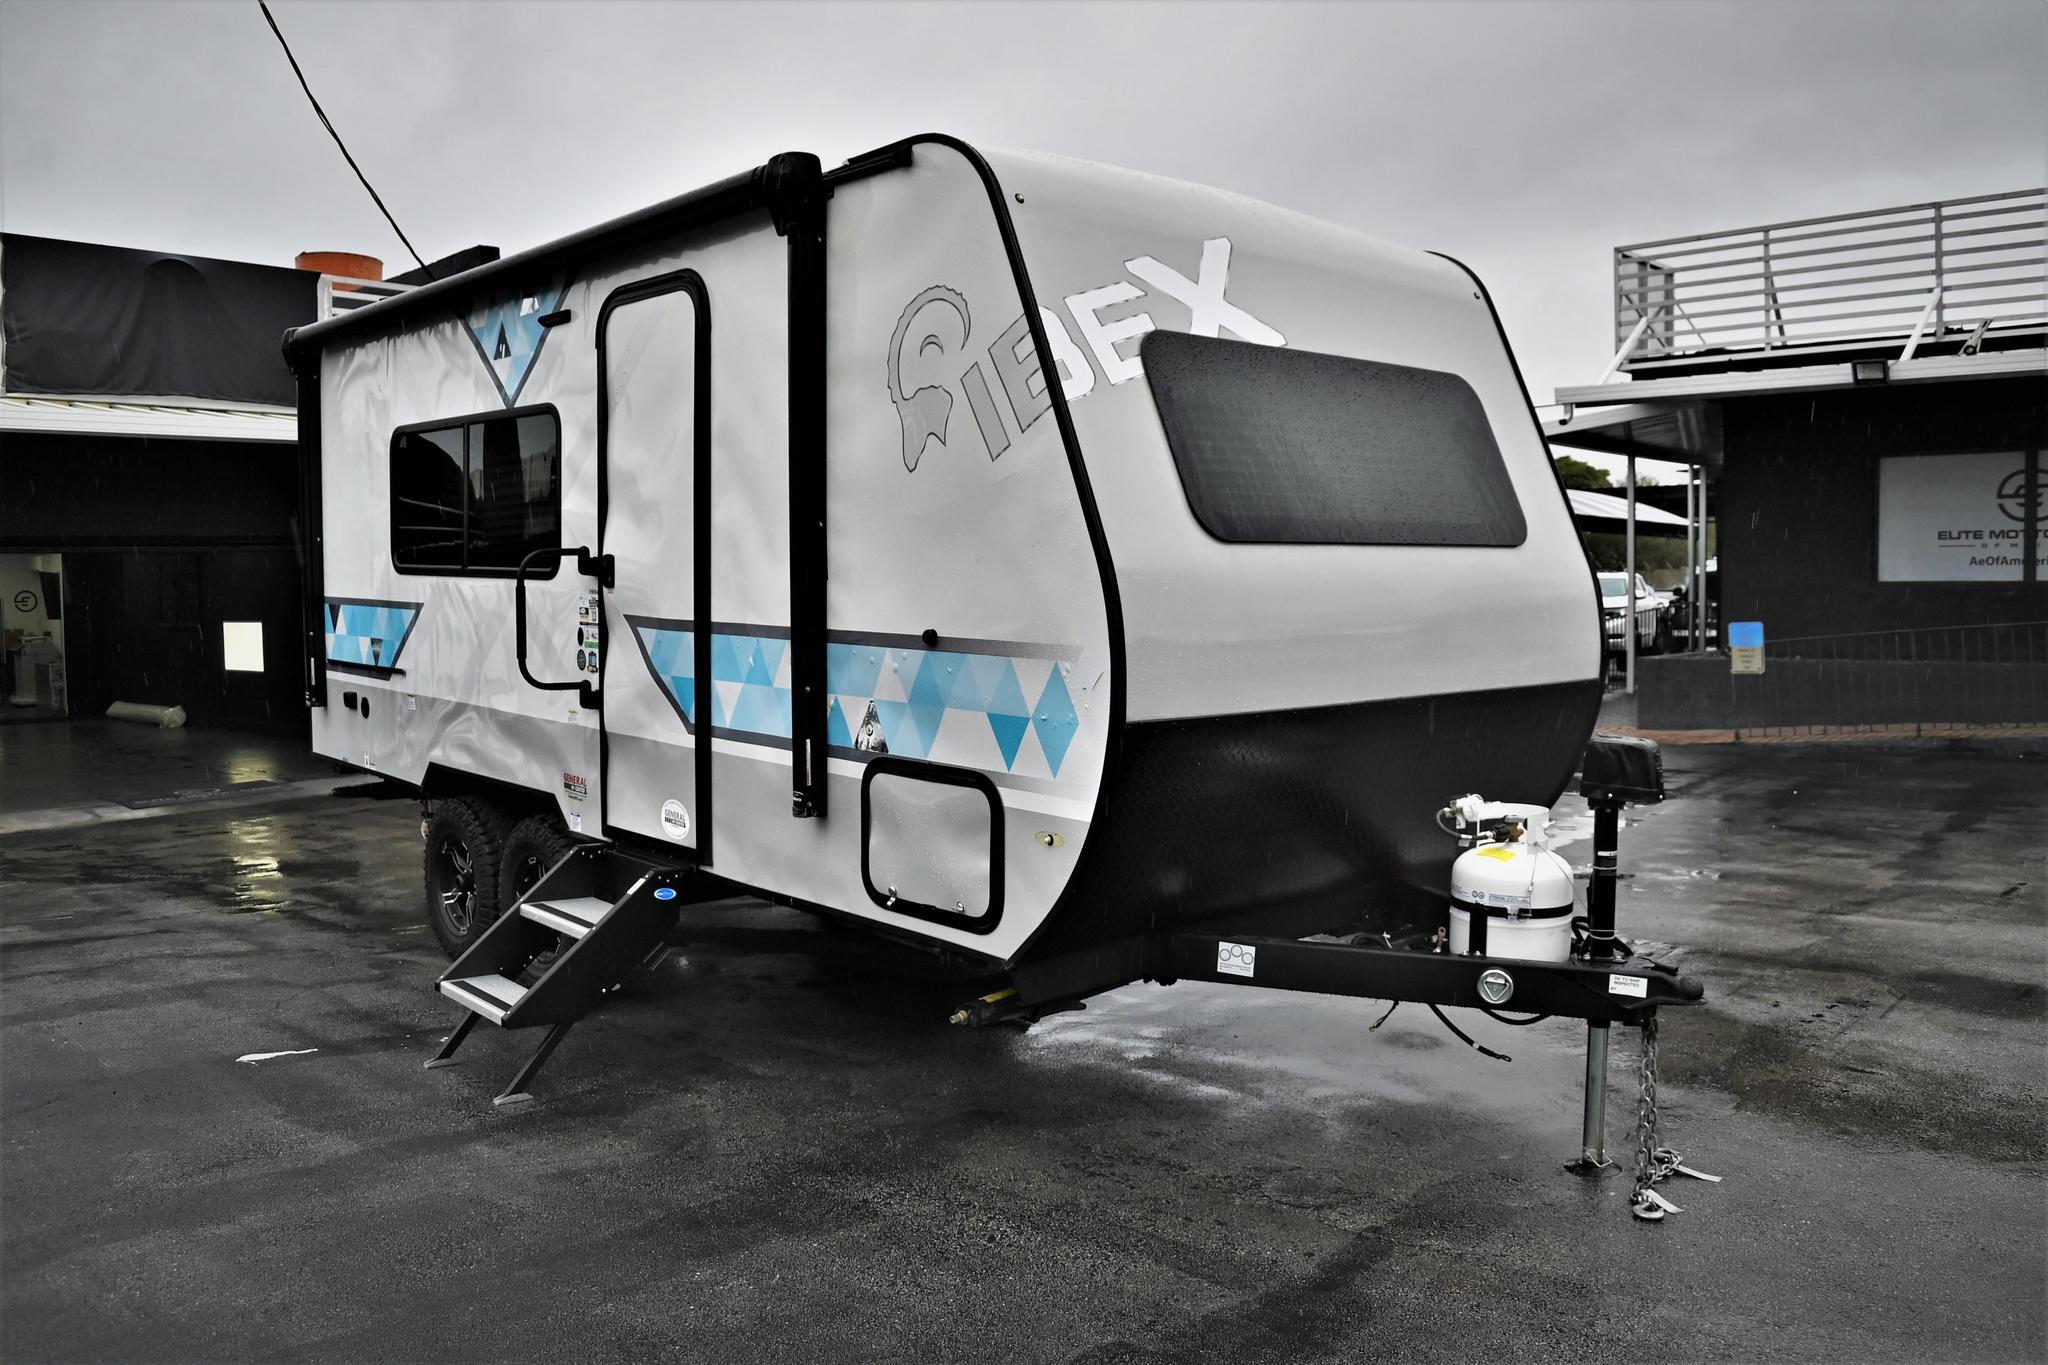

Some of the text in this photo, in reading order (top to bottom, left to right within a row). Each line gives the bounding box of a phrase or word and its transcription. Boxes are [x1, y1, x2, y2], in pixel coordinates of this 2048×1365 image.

[960, 237, 1288, 461] IBEX
[1937, 530, 1984, 540] ELITE
[563, 772, 587, 787] GENERAL
[664, 808, 686, 822] GENERAL
